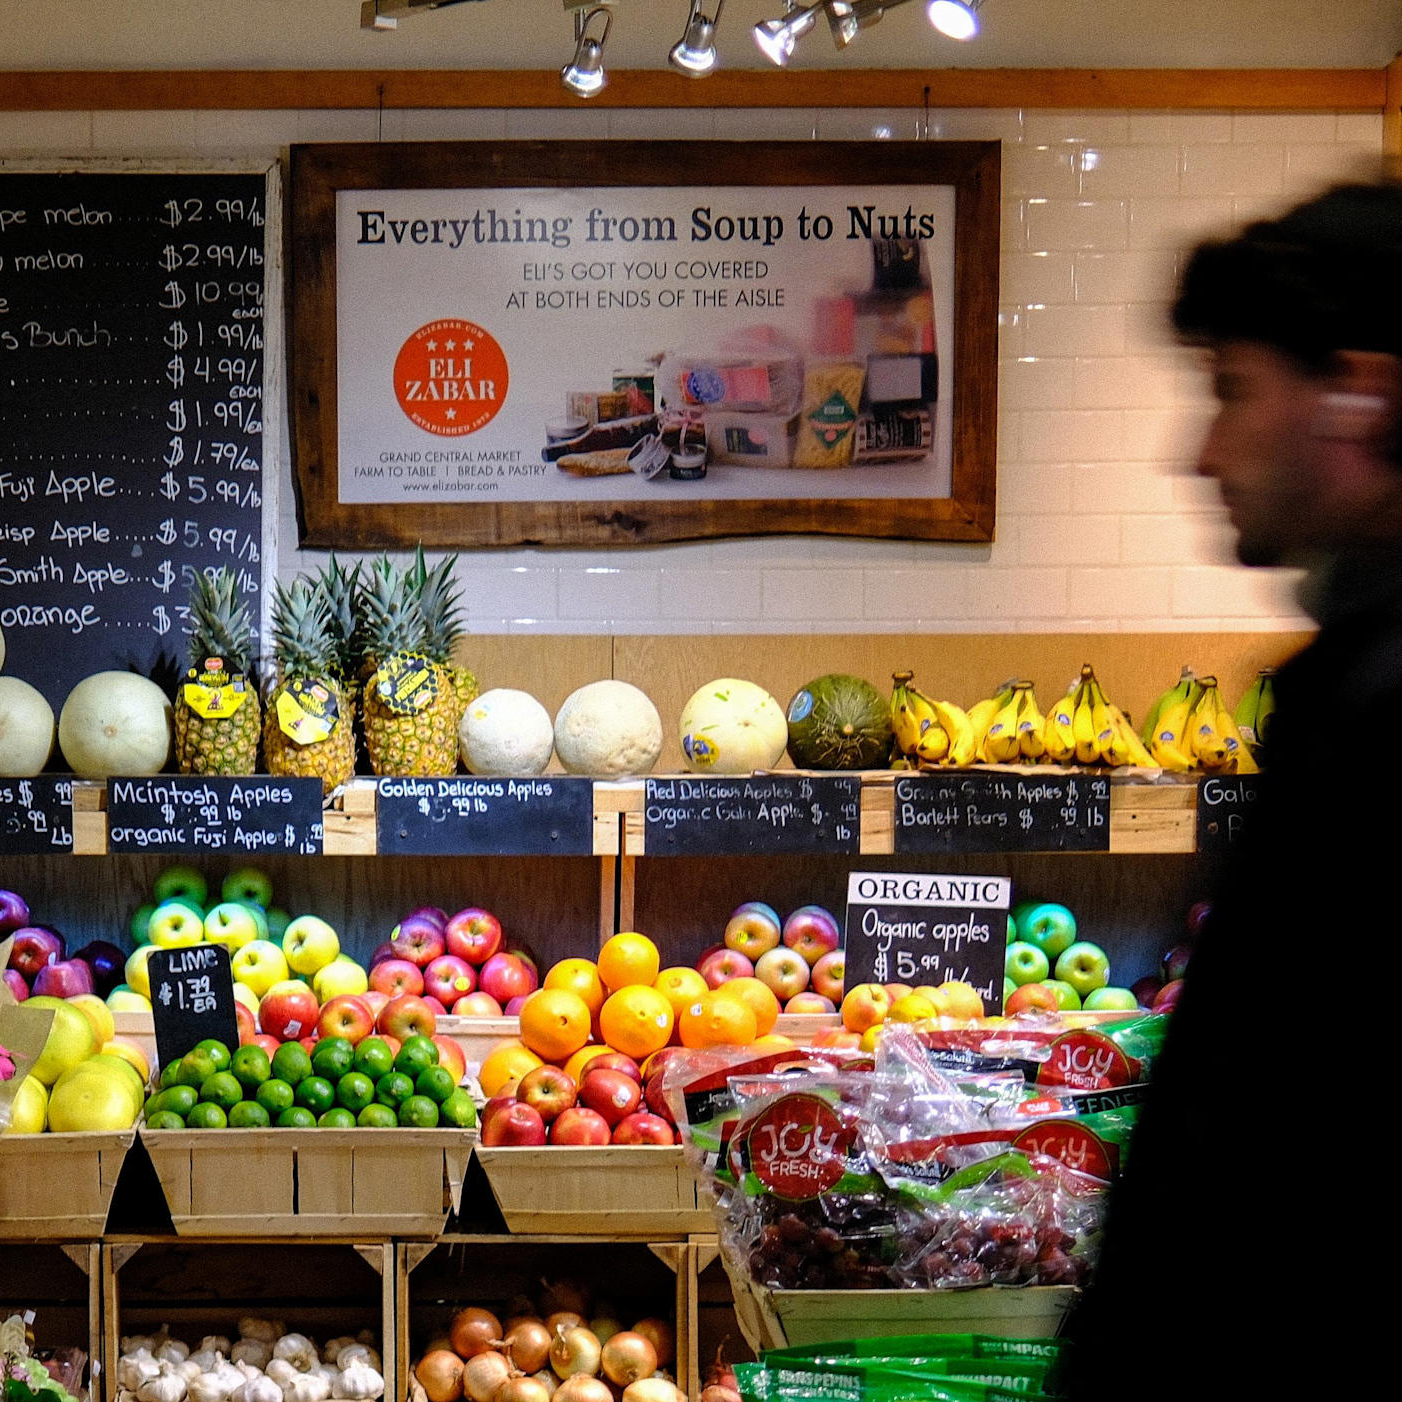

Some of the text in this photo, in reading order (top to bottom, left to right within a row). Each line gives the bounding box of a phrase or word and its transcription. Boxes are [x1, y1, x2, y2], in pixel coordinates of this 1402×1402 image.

[44, 203, 112, 226] melon
[357, 206, 935, 248] Everything from Soup to Nuts
[15, 249, 83, 271] melon
[571, 262, 616, 281] GOT
[623, 261, 666, 280] YOU
[675, 261, 769, 279] COVERED
[506, 288, 785, 309] AT BOTH ENDS OF THE AISLE
[22, 321, 111, 347] Bunch
[430, 358, 472, 379] ELI
[405, 380, 496, 401] ZABAR
[379, 451, 521, 463] GRAND CENTRAL MARKET
[354, 467, 384, 478] FARM
[389, 467, 403, 478] TO
[408, 467, 437, 477] TABLE
[458, 466, 493, 477] BREAD
[508, 465, 547, 476] PASTRY
[0, 473, 35, 502] Fuji
[45, 470, 116, 503] Apple
[403, 480, 498, 492] www.elizabar.com
[50, 520, 110, 548] Apple
[73, 562, 129, 593] Apple
[114, 781, 292, 809] Mcintosh Apples
[379, 778, 552, 801] Golden Delicious Apples
[680, 780, 741, 800] Delicious
[1018, 782, 1062, 804] Apples
[902, 803, 960, 826] Barlett
[967, 805, 1008, 827] Pears
[194, 827, 227, 848] Fuji
[234, 828, 277, 850] Apple
[858, 878, 1000, 903] ORGANIC
[862, 908, 990, 952] Organic apples
[770, 1160, 820, 1179] FRESH
